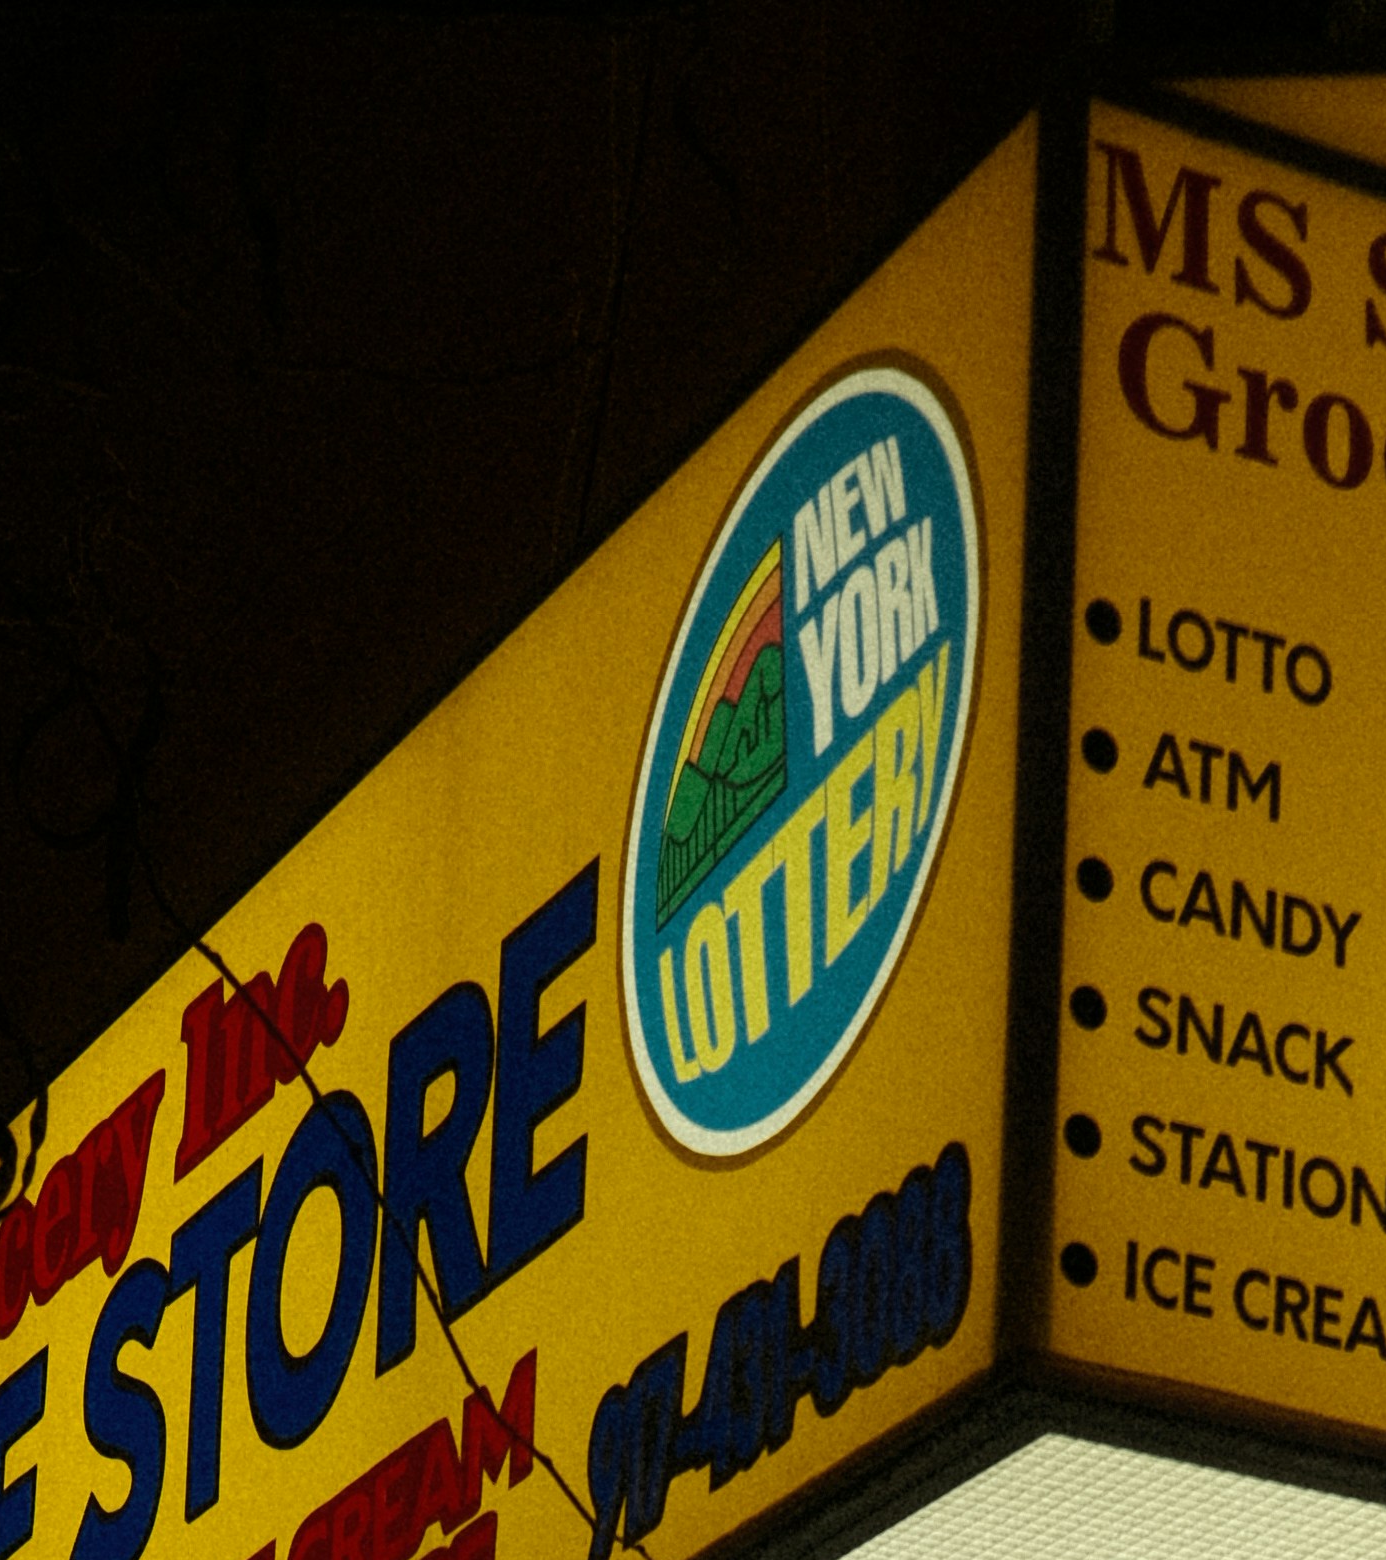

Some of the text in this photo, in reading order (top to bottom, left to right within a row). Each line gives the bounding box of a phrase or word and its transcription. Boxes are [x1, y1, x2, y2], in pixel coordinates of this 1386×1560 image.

[1092, 140, 1314, 321] MS
[792, 433, 908, 613] NEW
[798, 516, 940, 759] YORK
[1137, 596, 1333, 706] LOTTO
[1141, 731, 1283, 822] ATM
[658, 640, 952, 1085] LOTTERY
[1139, 860, 1362, 969] CANDY
[1134, 987, 1355, 1096] SNACK
[1124, 1240, 1215, 1320] ICE
